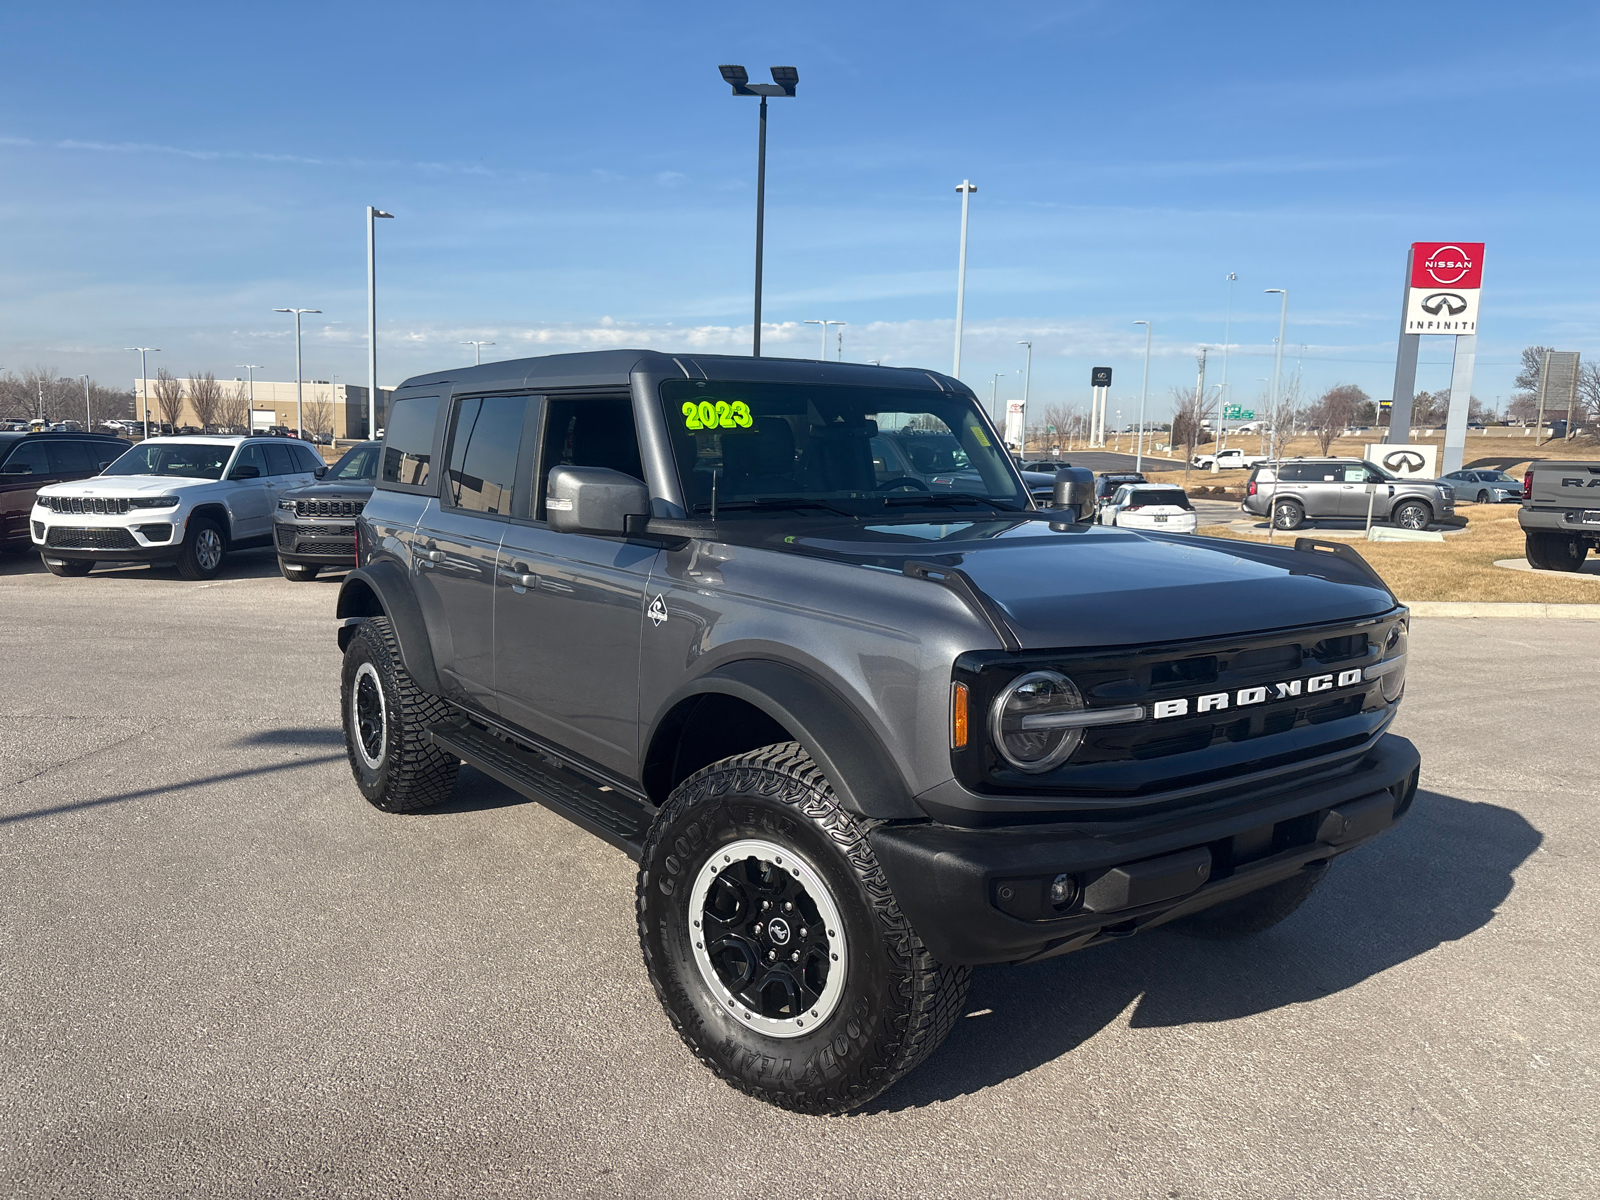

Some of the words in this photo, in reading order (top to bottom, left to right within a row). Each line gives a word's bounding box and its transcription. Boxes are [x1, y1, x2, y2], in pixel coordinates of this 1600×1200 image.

[1425, 261, 1472, 269] NISSAN
[1409, 320, 1475, 330] INFINITI
[682, 400, 753, 430] 2023
[1154, 668, 1362, 719] BRONCO
